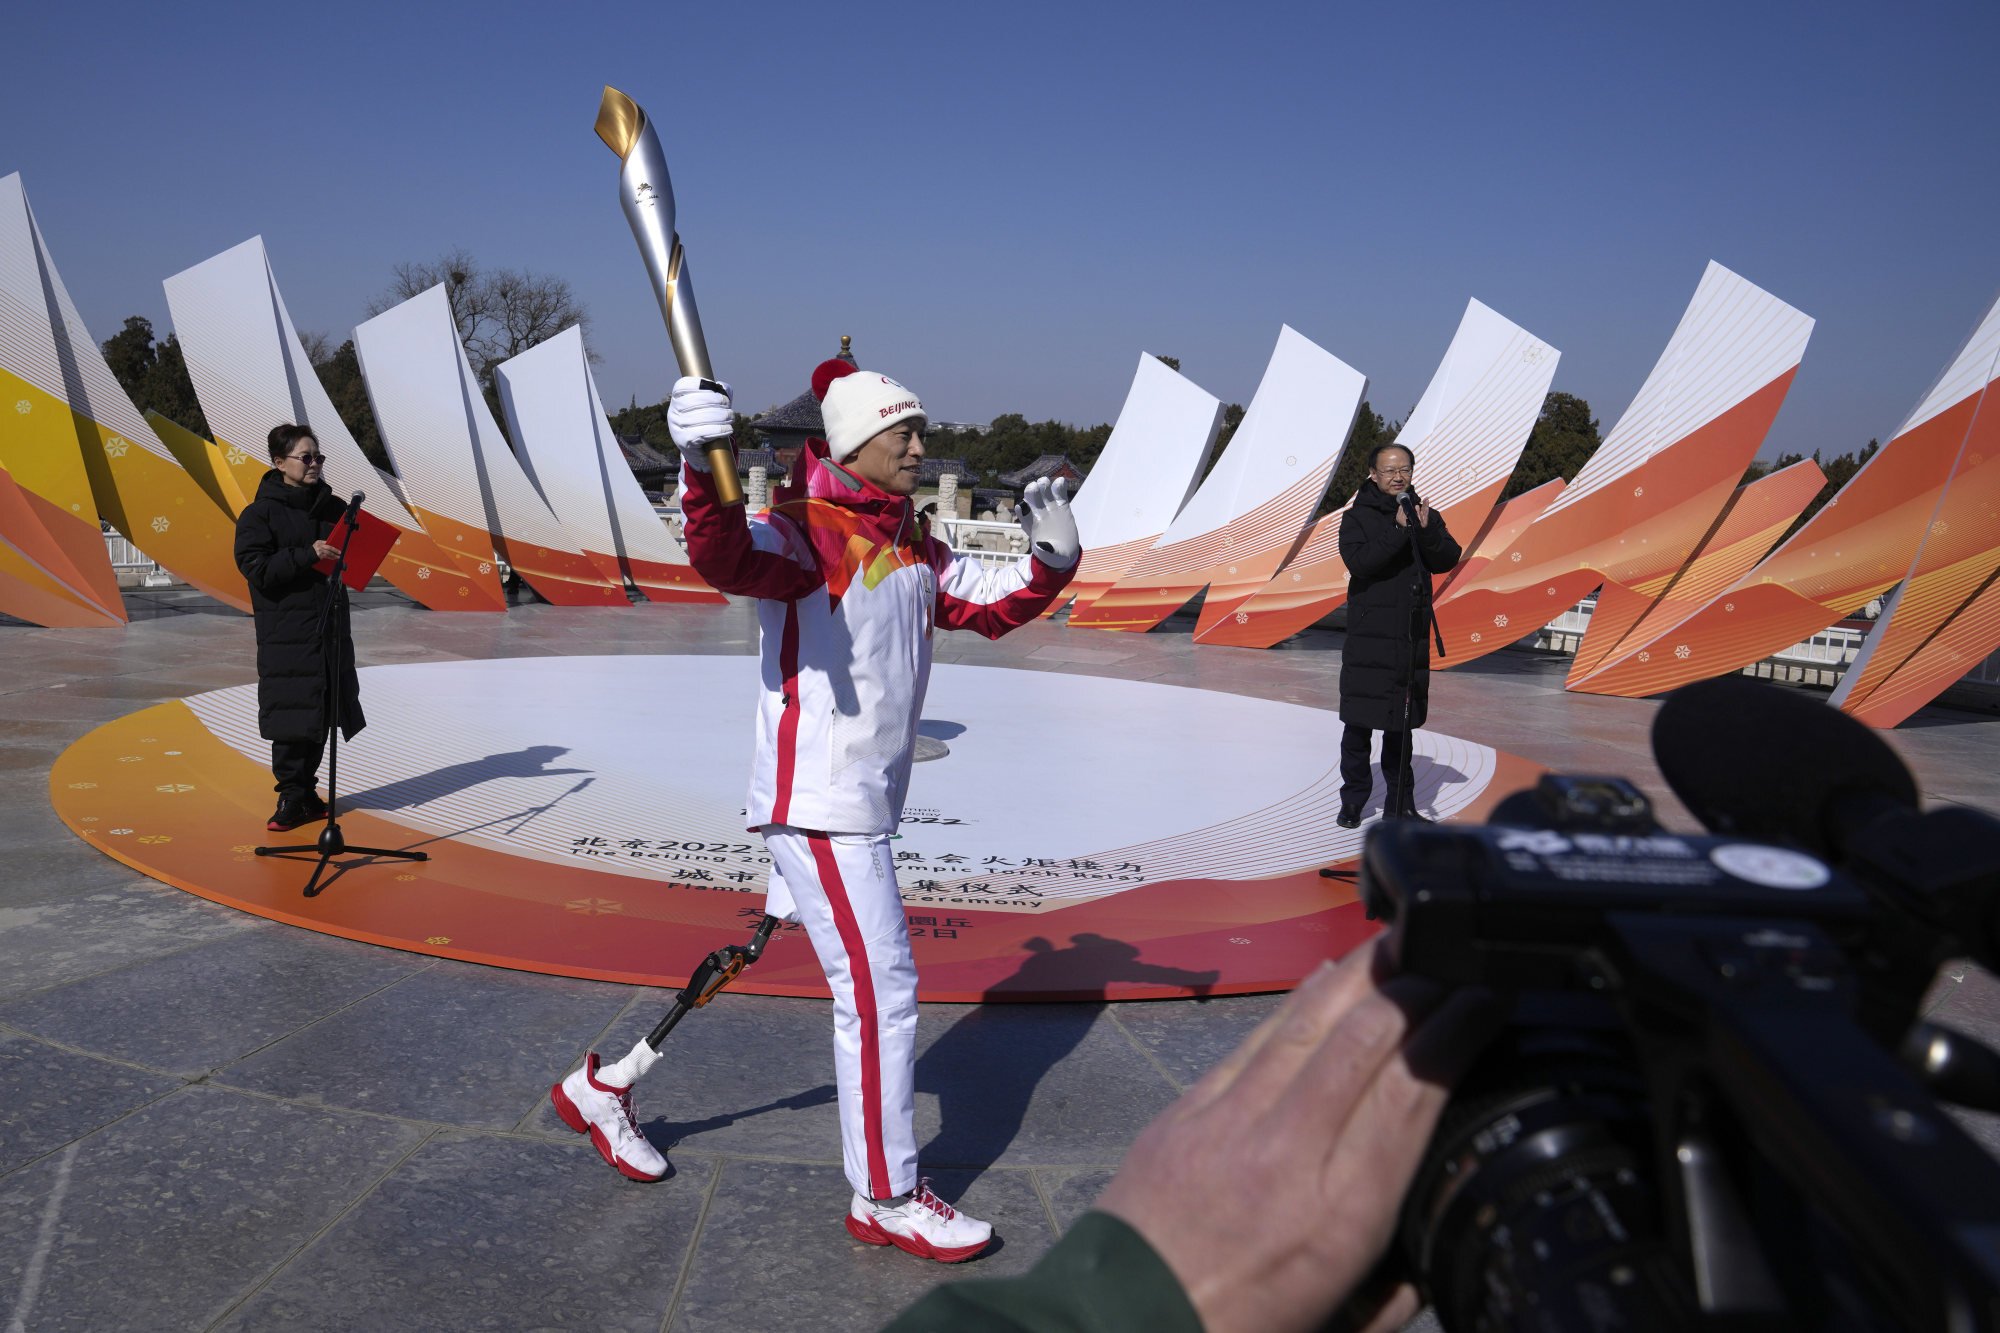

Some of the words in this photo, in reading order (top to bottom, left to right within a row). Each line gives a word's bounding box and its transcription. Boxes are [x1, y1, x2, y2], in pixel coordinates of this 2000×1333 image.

[879, 401, 916, 418] BEIJING
[572, 837, 769, 854] 北京2022
[570, 848, 617, 857] The
[630, 851, 726, 863] Beijing
[984, 867, 1060, 877] Torch
[1073, 872, 1145, 882] Relay
[871, 850, 885, 883] 2022
[668, 882, 752, 893] Flame
[901, 894, 1042, 908] Ceremony
[671, 869, 759, 883] 城市
[898, 879, 1043, 897] 集仪式
